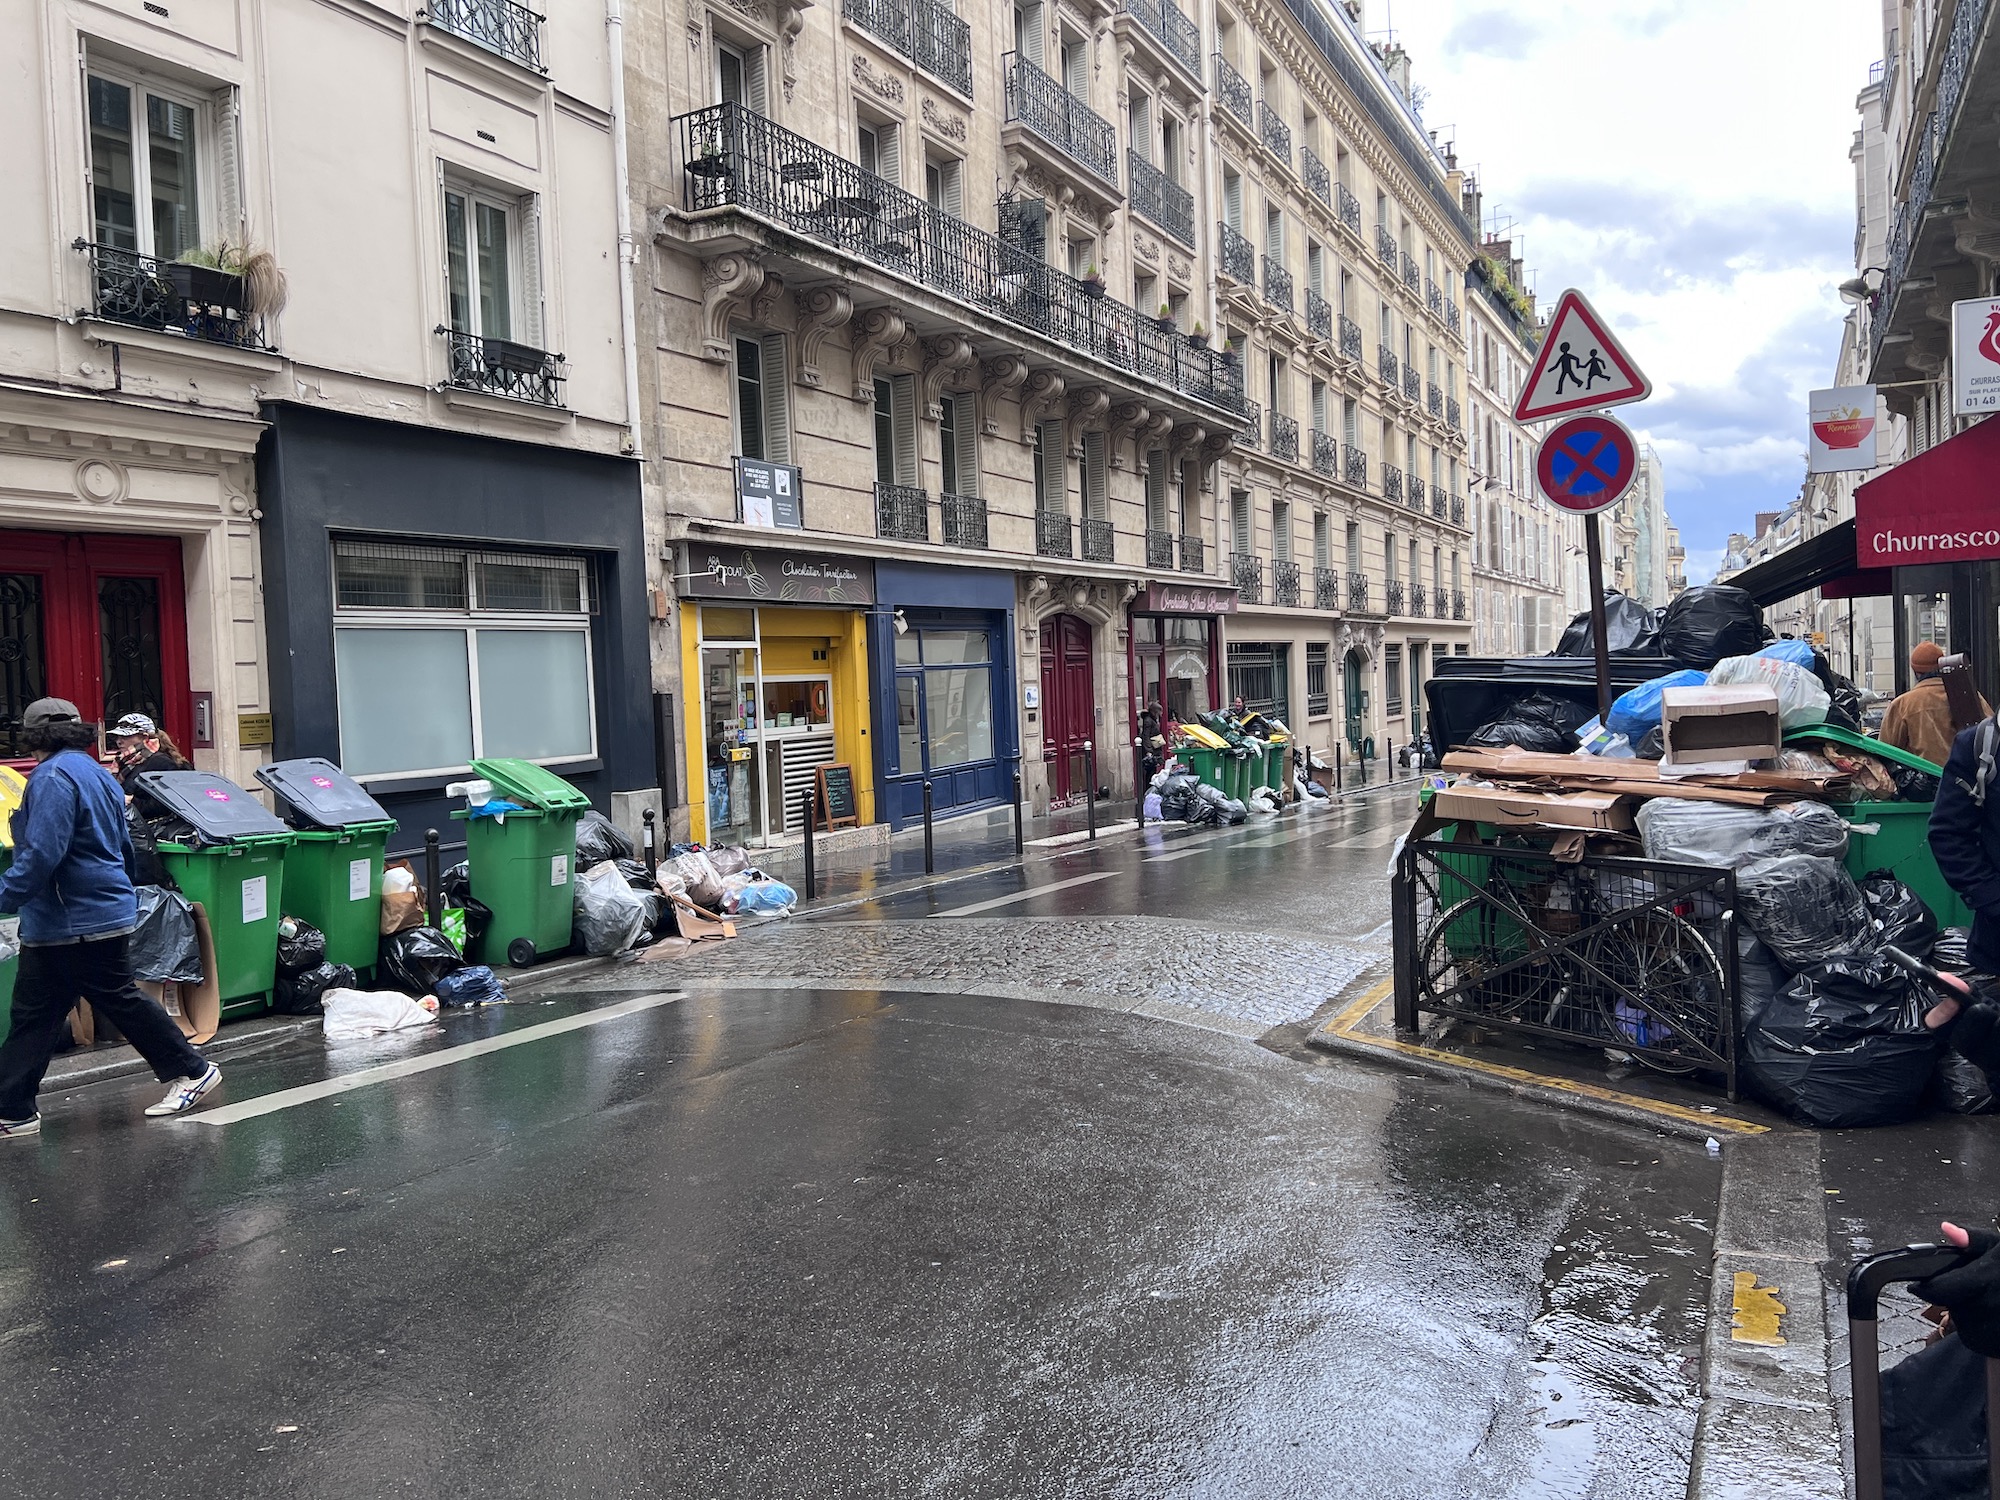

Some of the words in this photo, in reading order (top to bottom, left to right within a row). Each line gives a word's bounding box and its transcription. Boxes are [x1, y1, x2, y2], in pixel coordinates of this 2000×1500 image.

[1966, 397, 1978, 407] 01
[1982, 396, 1996, 405] 48
[1827, 421, 1861, 433] Rempah
[1873, 530, 2000, 553] Churrasco
[707, 556, 720, 566] ARA
[781, 559, 821, 577] Chocolatier
